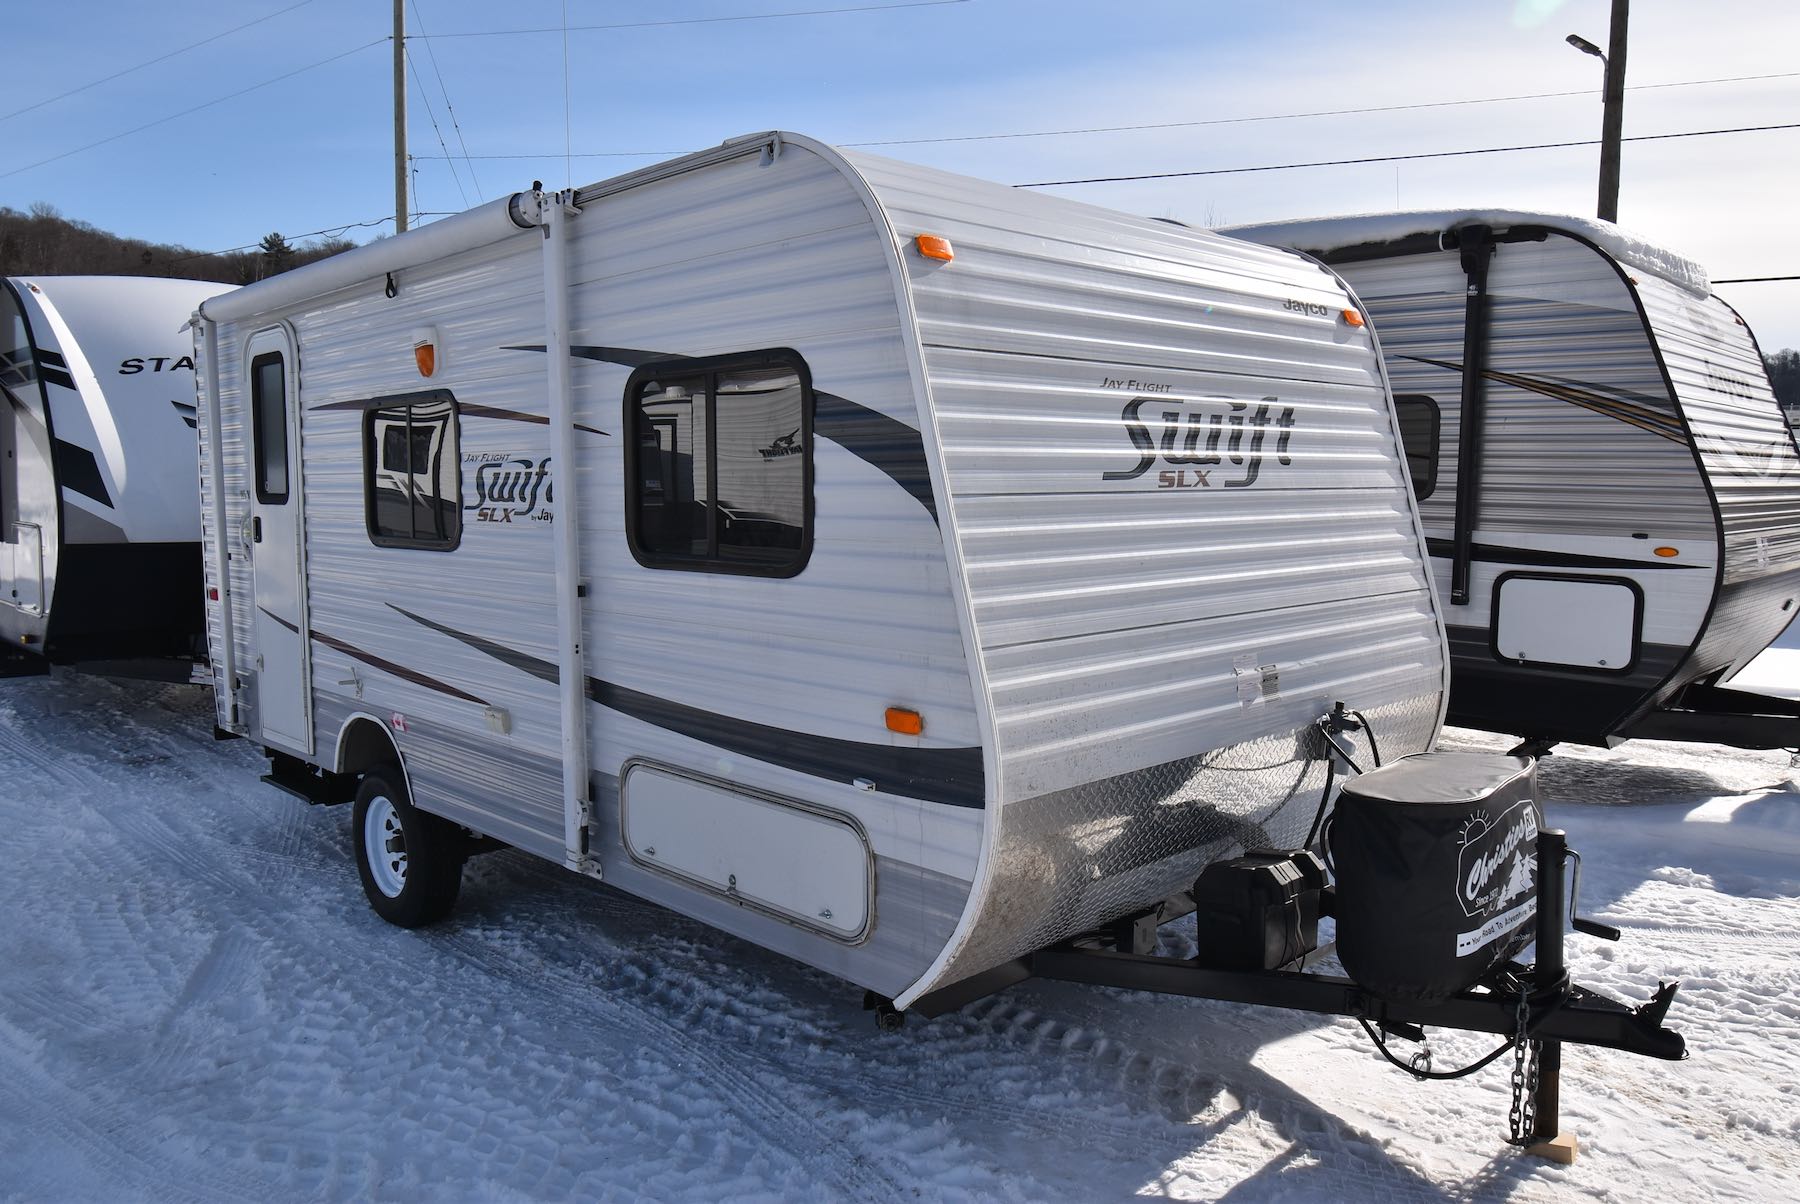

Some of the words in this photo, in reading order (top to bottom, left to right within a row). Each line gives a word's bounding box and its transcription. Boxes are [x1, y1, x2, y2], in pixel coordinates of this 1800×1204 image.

[1283, 299, 1328, 316] Jayco
[118, 356, 194, 375] STA
[1100, 377, 1125, 389] JAY
[1127, 380, 1172, 393] FLIGHT
[1102, 396, 1296, 487] Swift
[465, 454, 480, 462] JAY
[480, 454, 511, 462] FLIGHT
[1158, 470, 1211, 488] SLX
[477, 508, 515, 523] SLX
[1475, 895, 1489, 907] Since
[1482, 925, 1495, 937] Road
[1496, 921, 1503, 930] To
